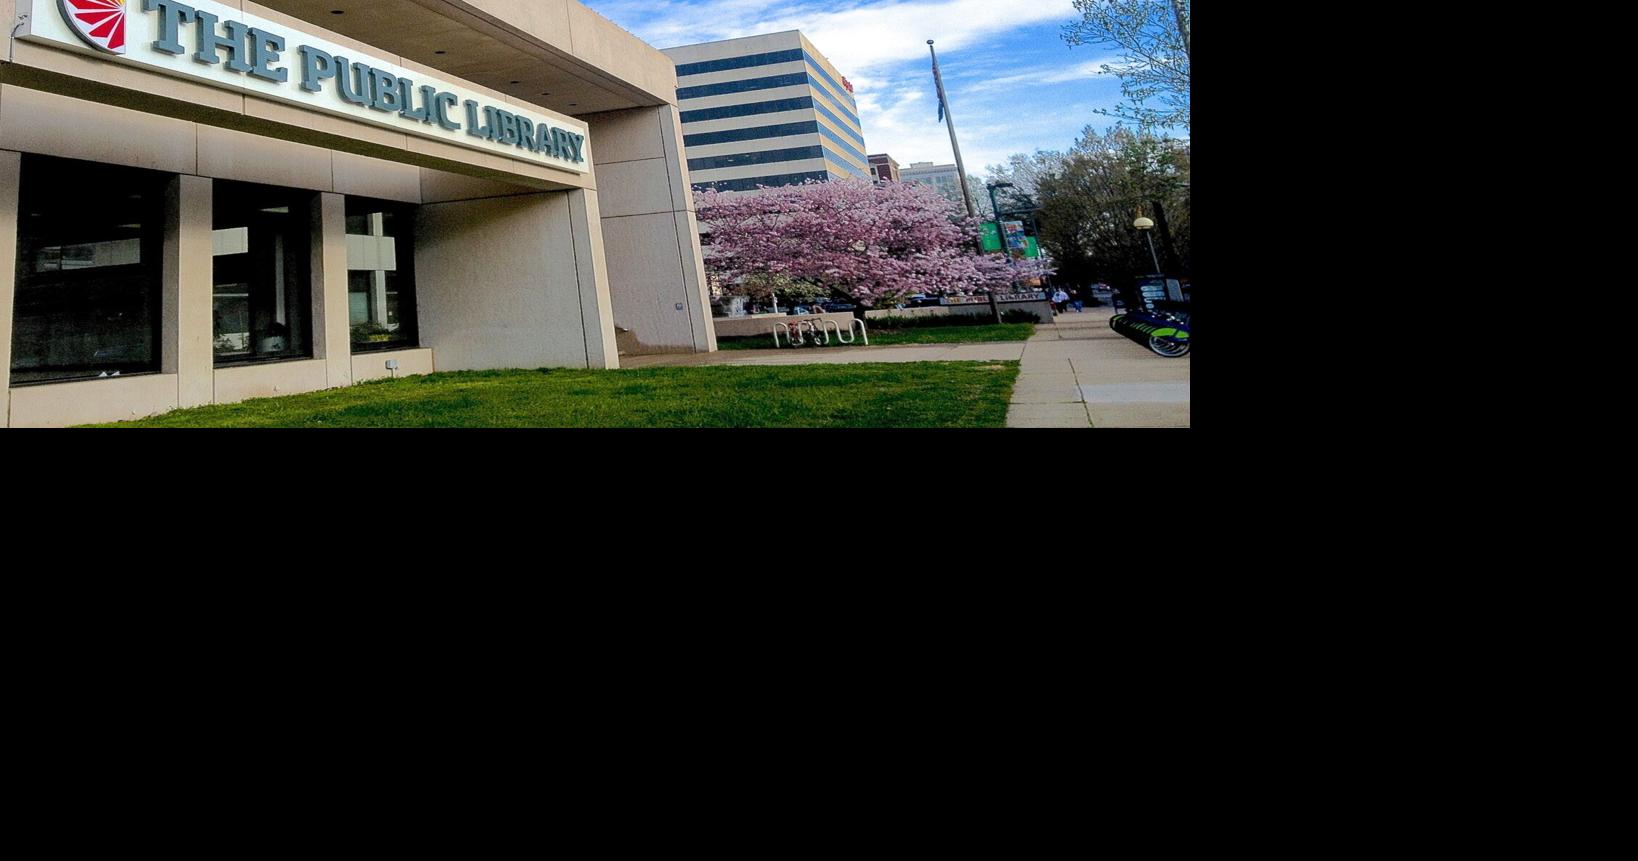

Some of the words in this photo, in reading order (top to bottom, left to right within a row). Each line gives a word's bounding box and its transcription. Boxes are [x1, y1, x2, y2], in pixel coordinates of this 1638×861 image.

[141, 0, 288, 83] THE
[298, 44, 461, 131] PUBLIC
[465, 99, 584, 163] LIBRARY
